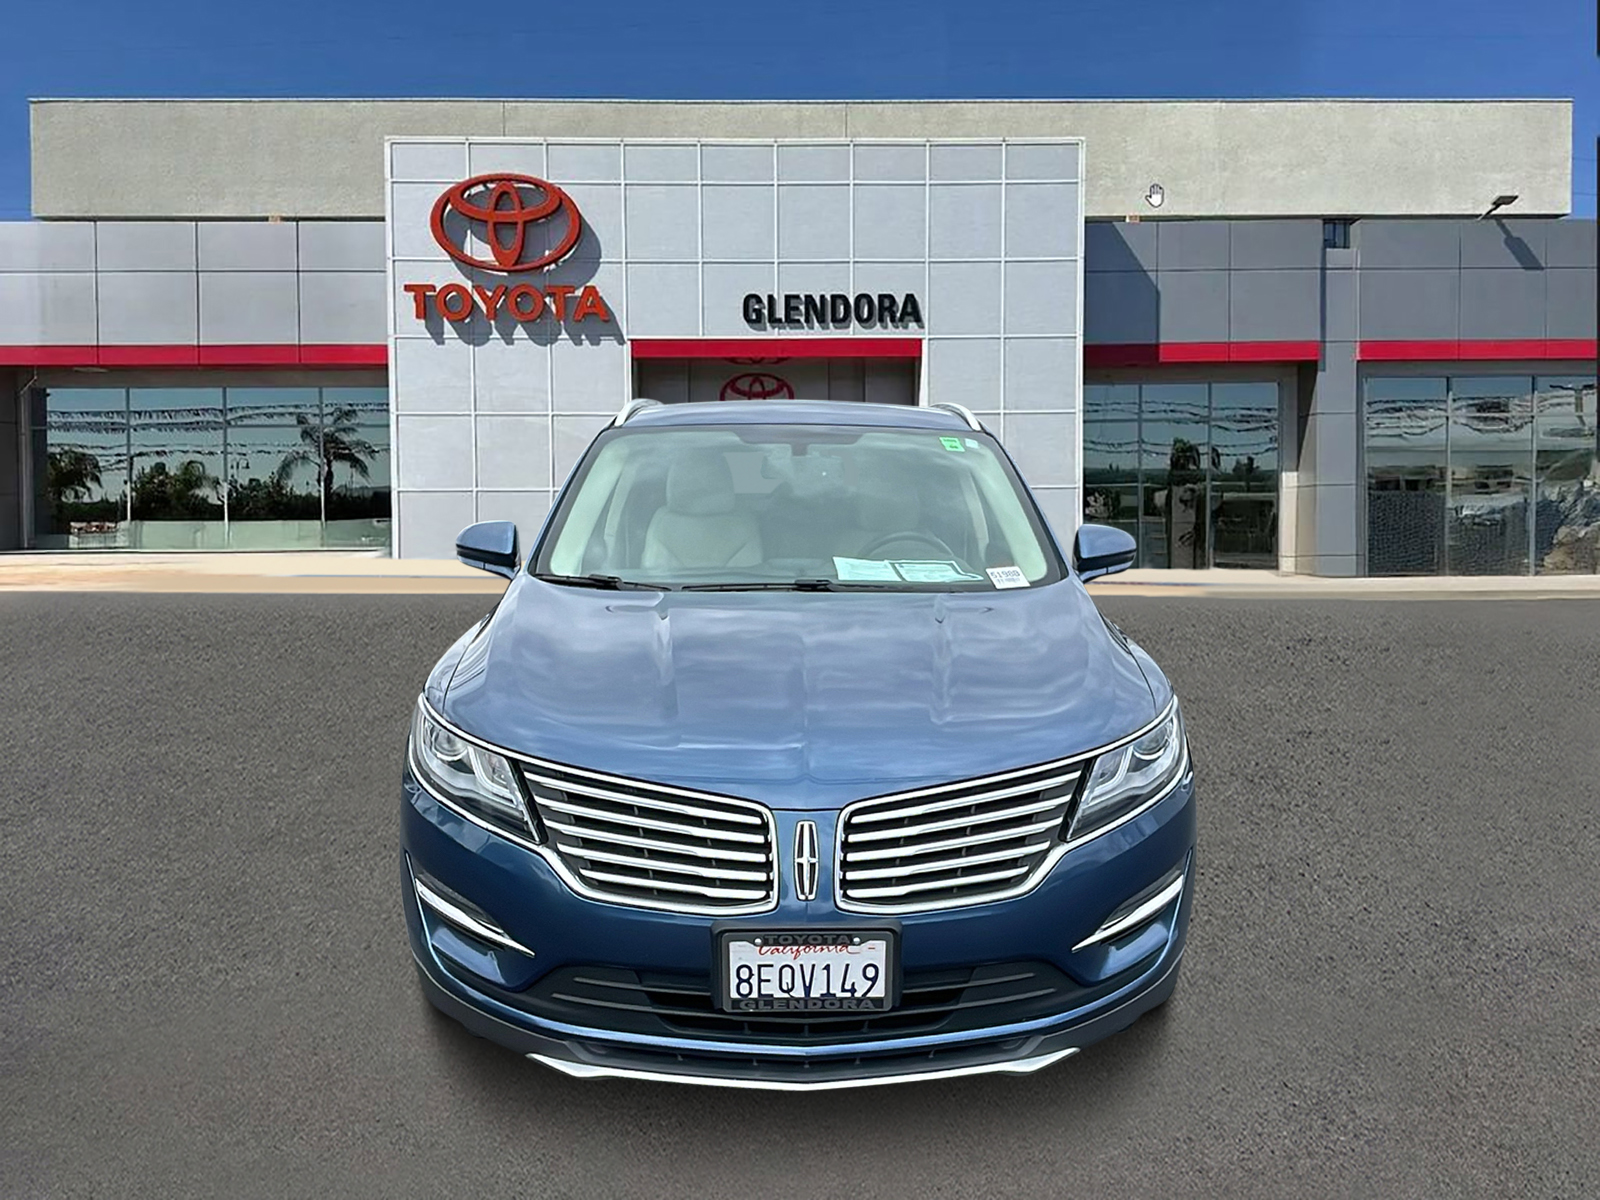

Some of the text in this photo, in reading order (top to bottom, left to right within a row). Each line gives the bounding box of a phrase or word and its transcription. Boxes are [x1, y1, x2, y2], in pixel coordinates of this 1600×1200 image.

[404, 283, 610, 322] TOYOTA
[743, 293, 922, 325] GLENDORA
[758, 944, 861, 960] California
[765, 935, 850, 945] TOYOTA
[736, 963, 879, 998] 8EQV149
[740, 1000, 876, 1010] GLENDORA
